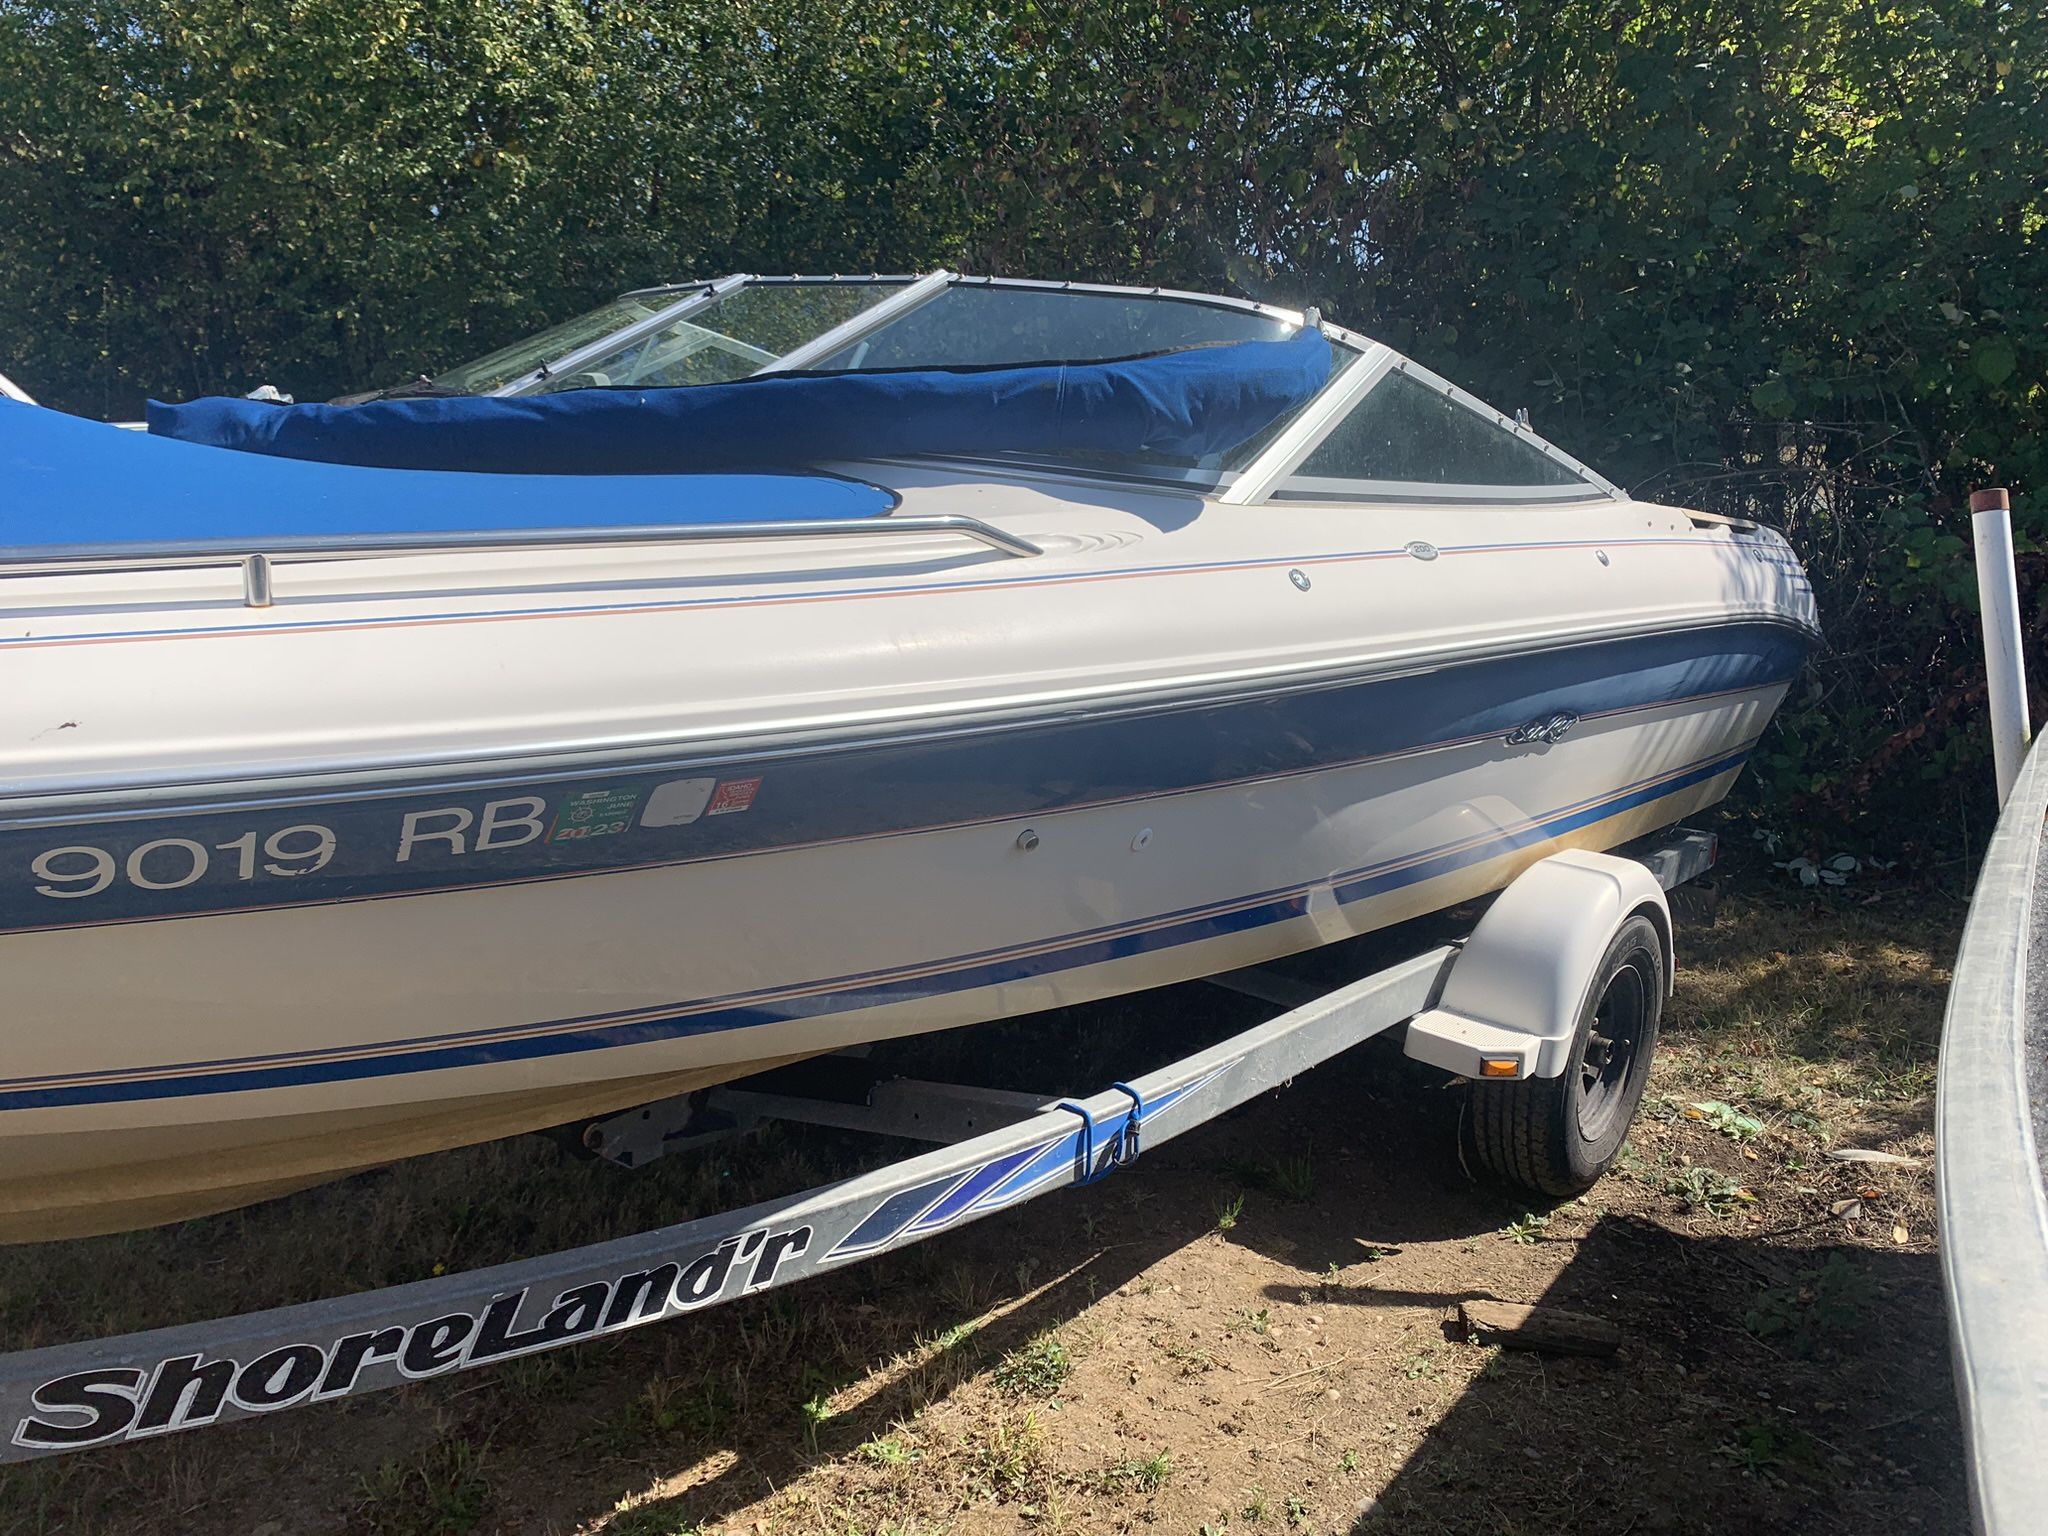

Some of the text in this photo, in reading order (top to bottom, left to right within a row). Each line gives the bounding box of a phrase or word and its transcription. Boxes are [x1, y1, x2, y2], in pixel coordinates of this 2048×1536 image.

[569, 793, 638, 807] WASHINGTON
[607, 801, 634, 810] JUNE
[555, 821, 625, 841] 2023
[31, 796, 547, 898] 9019 RB
[12, 1225, 813, 1450] ShoreLand'r
